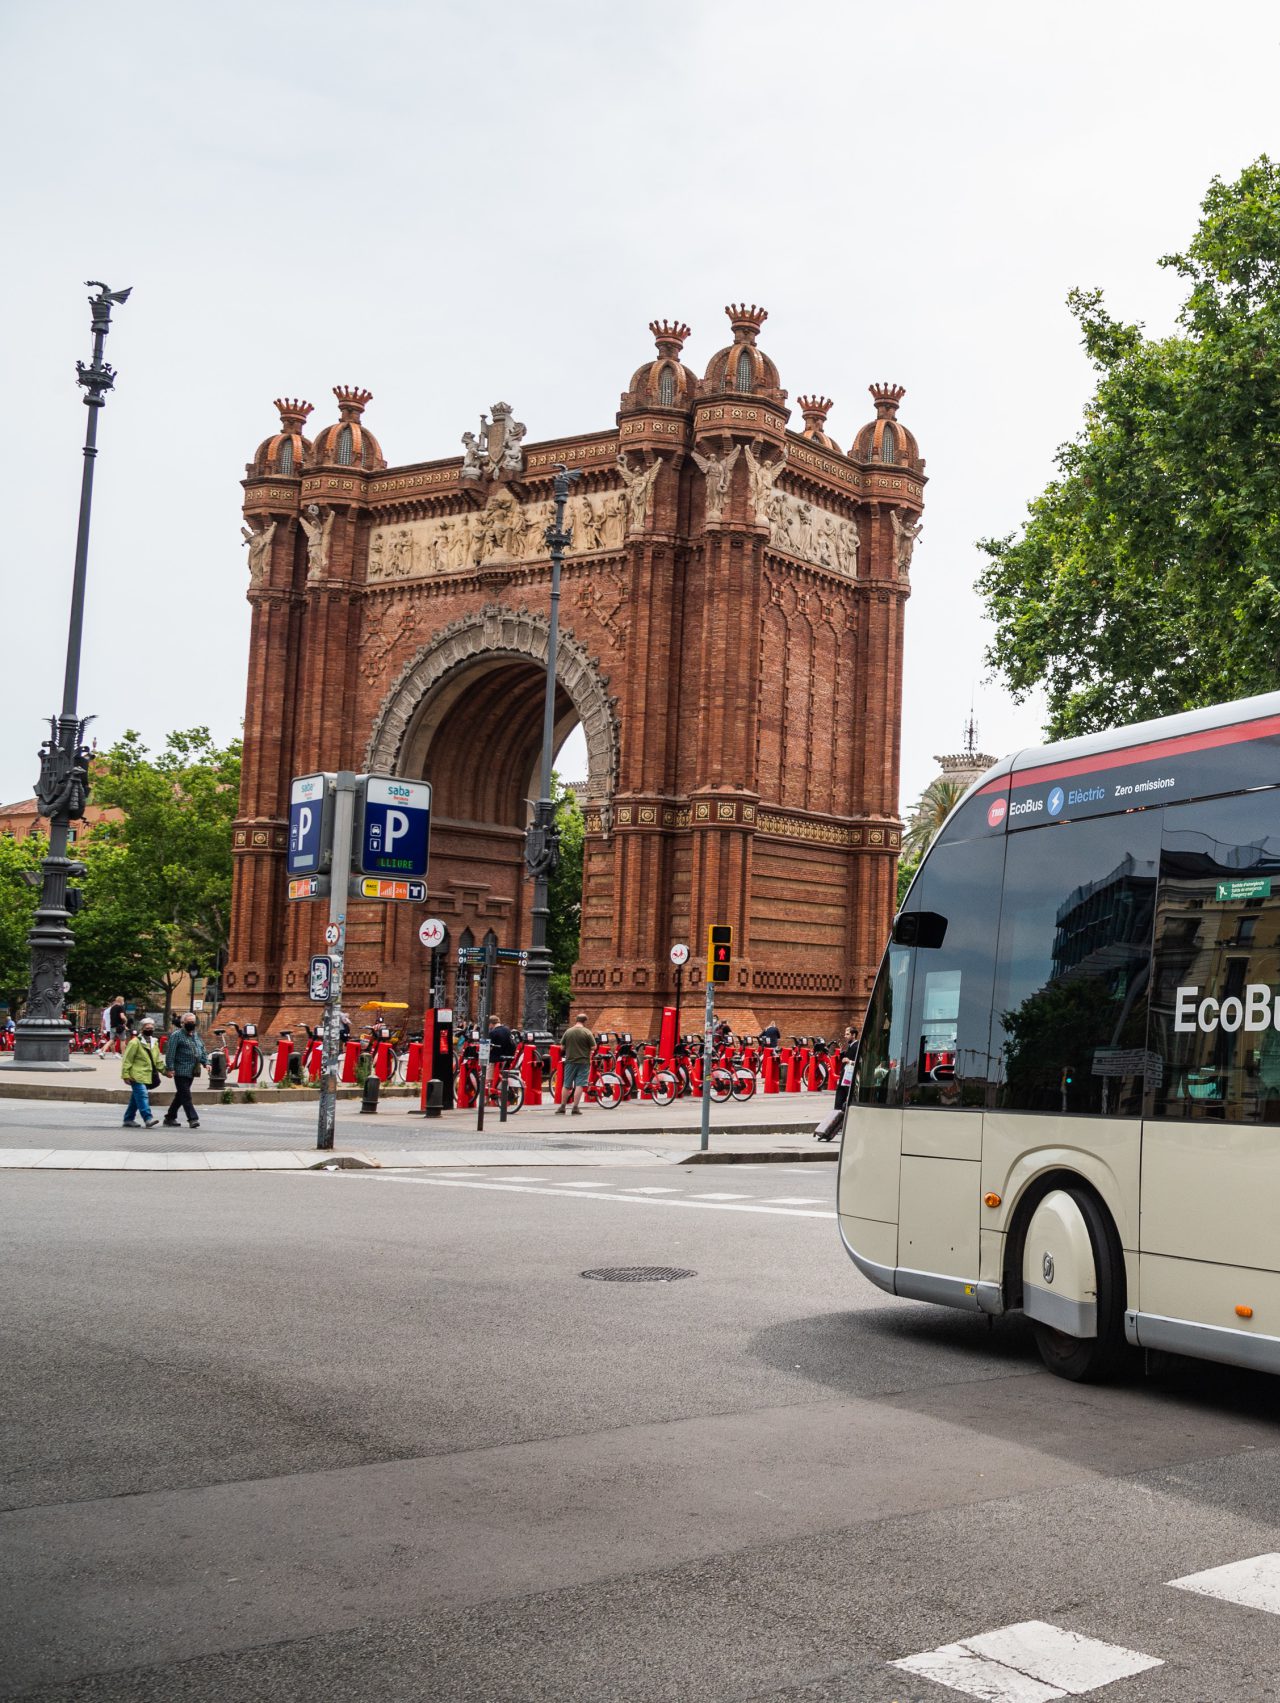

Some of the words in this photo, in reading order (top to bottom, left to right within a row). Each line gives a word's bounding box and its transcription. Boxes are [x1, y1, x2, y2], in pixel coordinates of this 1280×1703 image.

[388, 785, 410, 797] saba
[1068, 786, 1105, 805] Elèctric
[1114, 784, 1133, 797] Zero
[1134, 776, 1175, 793] emissions
[991, 808, 1004, 817] TMB
[1009, 799, 1043, 816] EcoBus
[298, 807, 312, 851] P
[384, 809, 409, 853] P
[327, 930, 333, 939] 2
